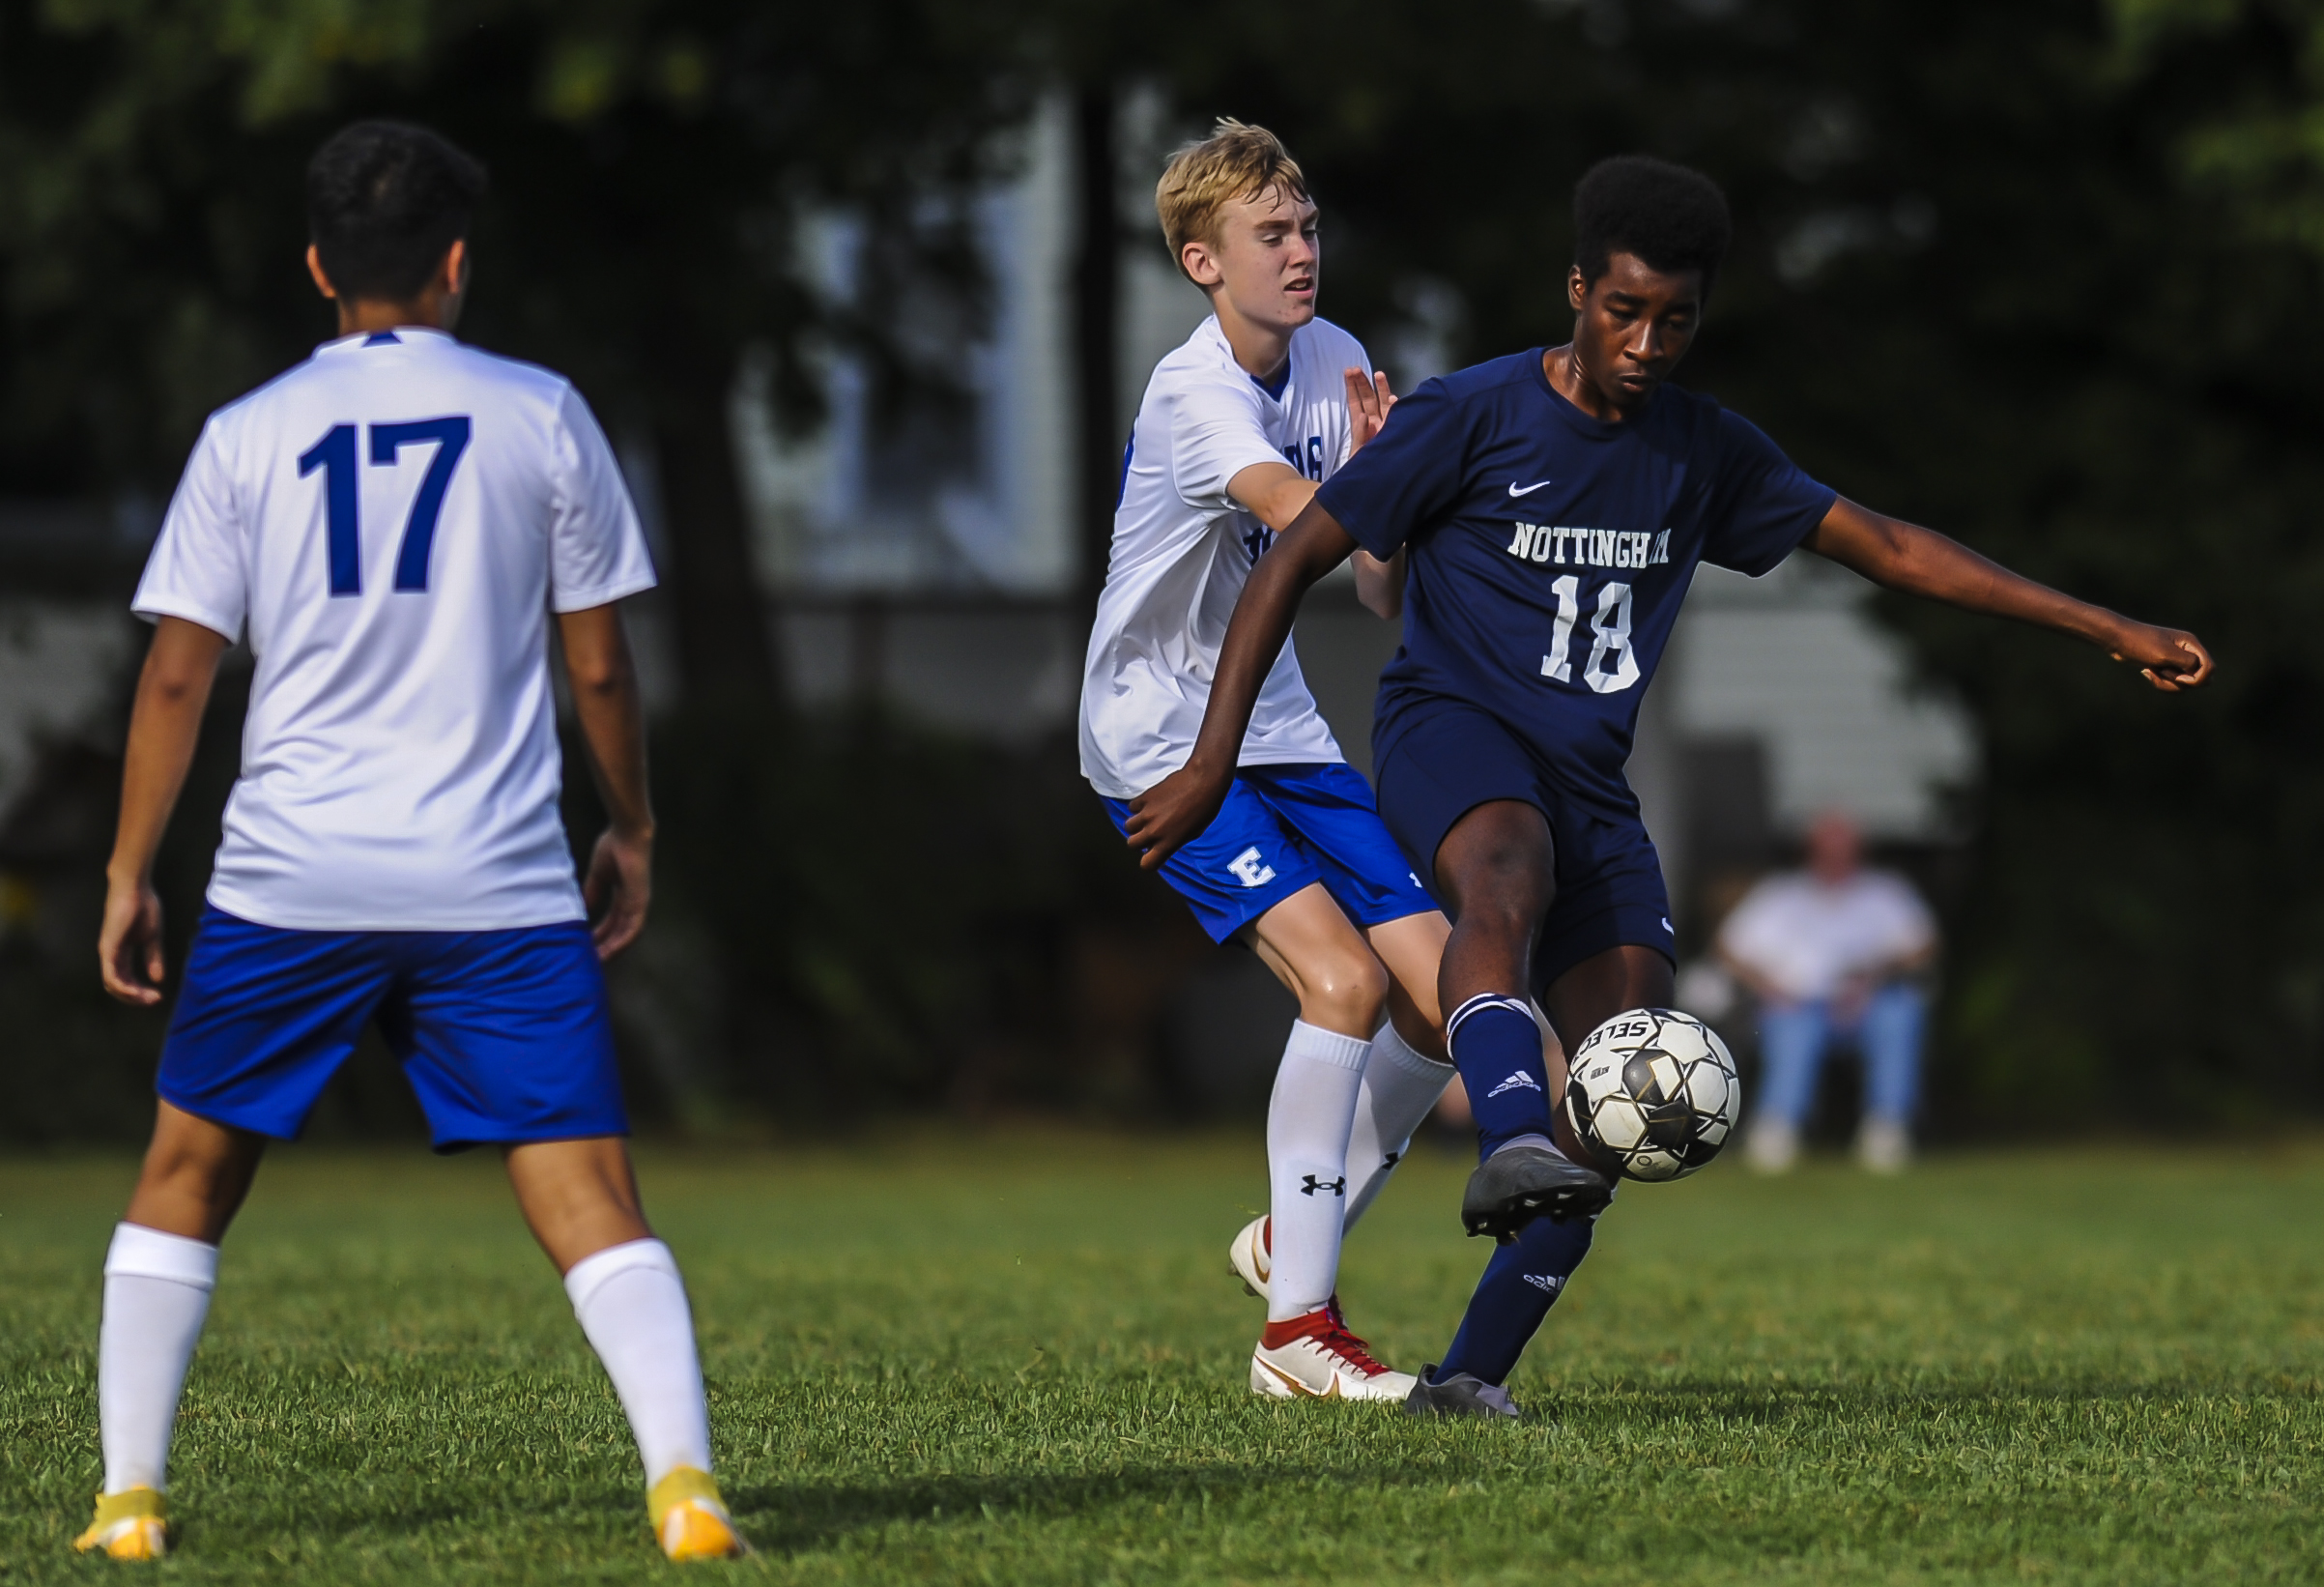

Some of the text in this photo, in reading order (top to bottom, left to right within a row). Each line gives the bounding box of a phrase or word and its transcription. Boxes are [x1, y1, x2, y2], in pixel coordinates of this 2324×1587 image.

[298, 416, 472, 595] 17
[1507, 522, 1671, 568] NOTTINGHM
[1541, 575, 1641, 694] 18
[1227, 846, 1277, 887] E
[1573, 1021, 1650, 1060] SELEC
